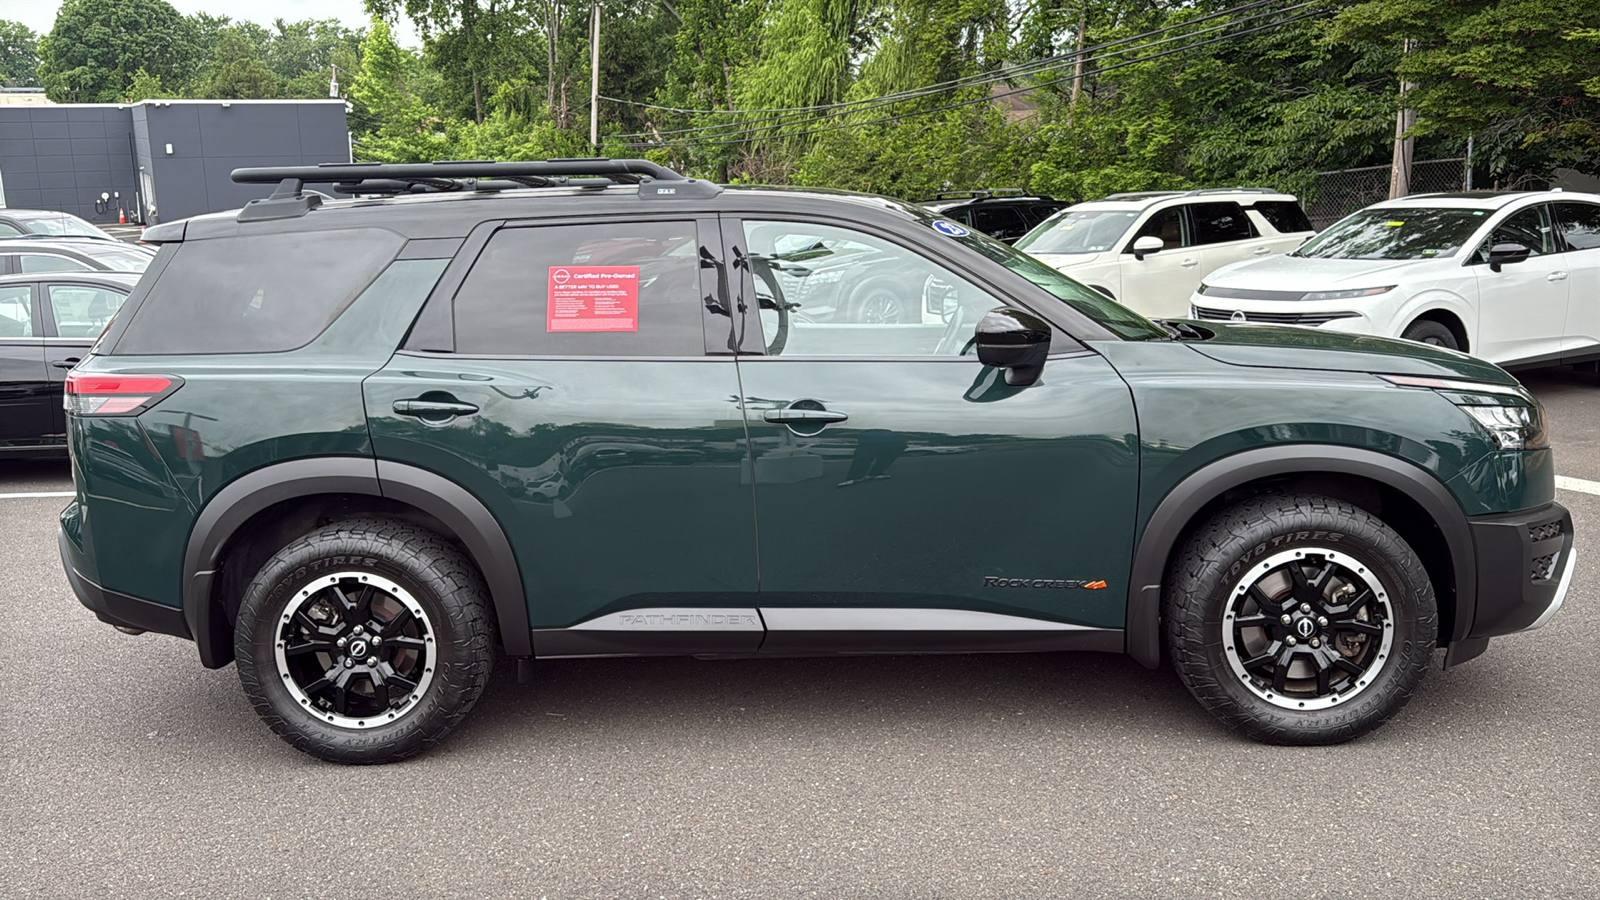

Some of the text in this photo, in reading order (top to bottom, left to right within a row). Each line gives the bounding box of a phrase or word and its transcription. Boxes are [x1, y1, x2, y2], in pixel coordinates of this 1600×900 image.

[1271, 530, 1345, 547] TIRES
[309, 556, 378, 570] TIRES
[983, 576, 1087, 589] ROCK CREEK
[619, 614, 756, 626] PATHFINDER
[1291, 692, 1382, 729] COUNTRY
